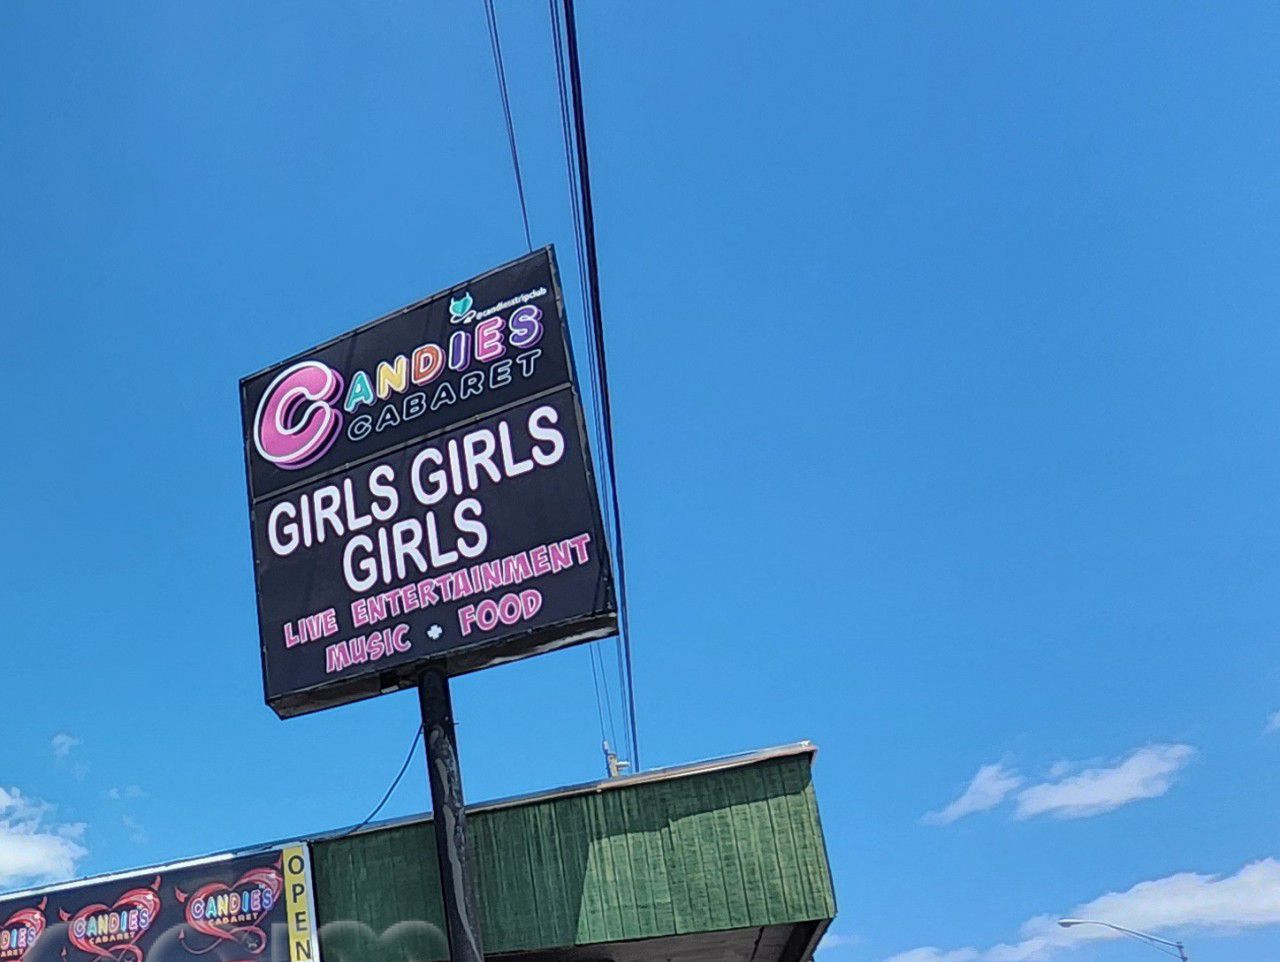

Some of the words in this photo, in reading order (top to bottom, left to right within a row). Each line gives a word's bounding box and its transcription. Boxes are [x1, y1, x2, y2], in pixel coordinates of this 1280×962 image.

[253, 305, 544, 470] CANDIES
[347, 349, 542, 442] CABARET
[267, 464, 400, 557] GIRLS
[411, 405, 565, 506] GIRLS
[283, 608, 338, 649] LIVE
[351, 533, 591, 628] ENTERTAINMENT
[342, 498, 488, 592] GIRLS
[325, 624, 412, 673] MUSIC
[457, 589, 543, 636] FOOD
[73, 907, 150, 939] CANDIES
[89, 931, 137, 945] CABARET
[191, 886, 274, 919] CANDIES
[287, 854, 312, 962] OPEN
